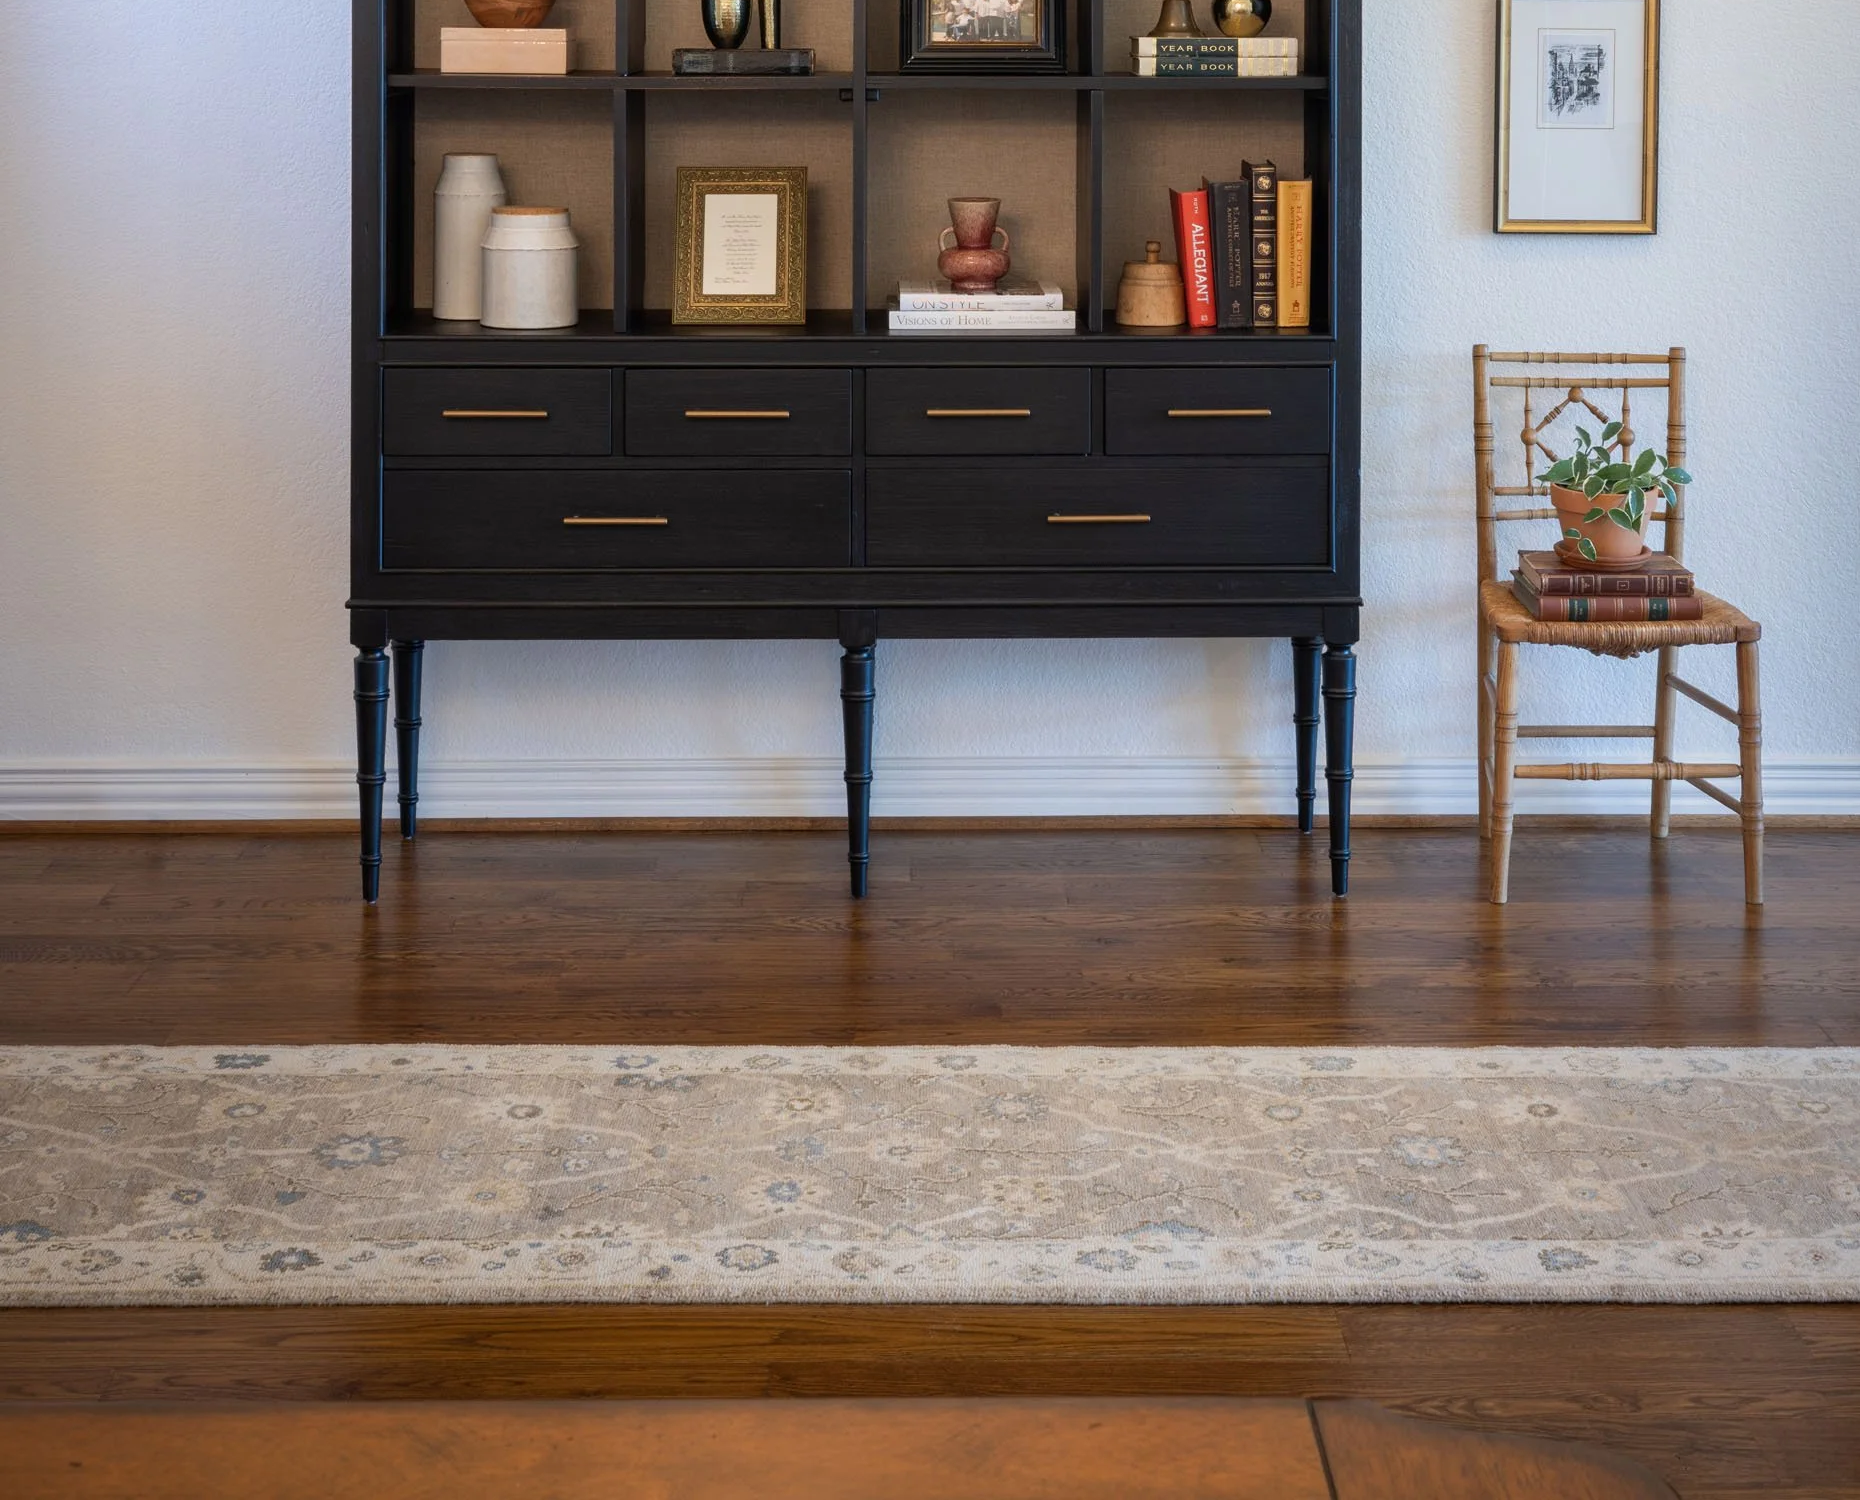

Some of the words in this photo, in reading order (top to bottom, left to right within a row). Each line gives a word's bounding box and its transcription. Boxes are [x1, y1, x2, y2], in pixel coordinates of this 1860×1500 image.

[1295, 206, 1303, 244] HARRY
[1191, 223, 1209, 304] ALLEGIANT
[1234, 248, 1242, 287] POTTER
[1295, 249, 1303, 287] POTTER
[897, 314, 937, 325] VISIONS
[958, 314, 992, 325] HOME
